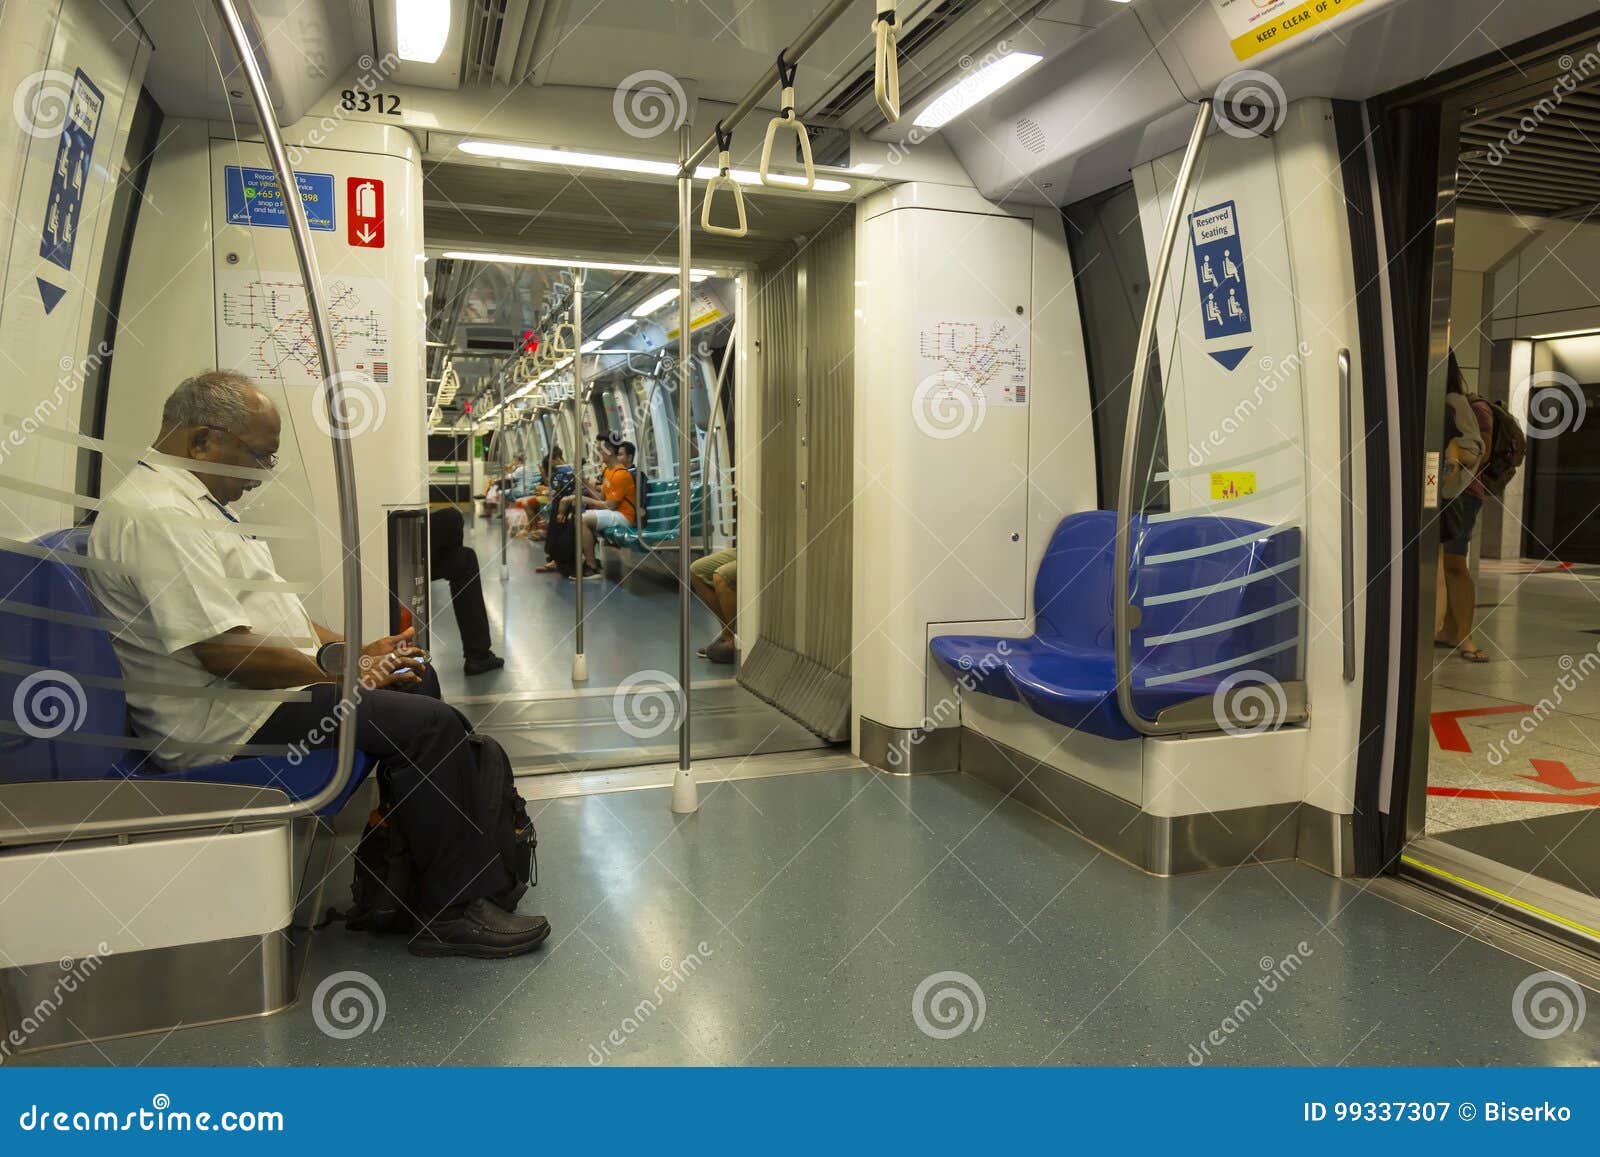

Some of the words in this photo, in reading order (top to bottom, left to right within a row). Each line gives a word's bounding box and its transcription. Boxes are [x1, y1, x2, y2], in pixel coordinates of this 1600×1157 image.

[1256, 27, 1277, 43] KEEP
[1282, 10, 1311, 31] CLEAR
[1315, 1, 1329, 14] OF
[341, 90, 402, 116] 8312
[257, 190, 273, 198] +65
[302, 193, 319, 202] 398
[1196, 209, 1229, 228] Reserved
[1201, 225, 1229, 240] Seating
